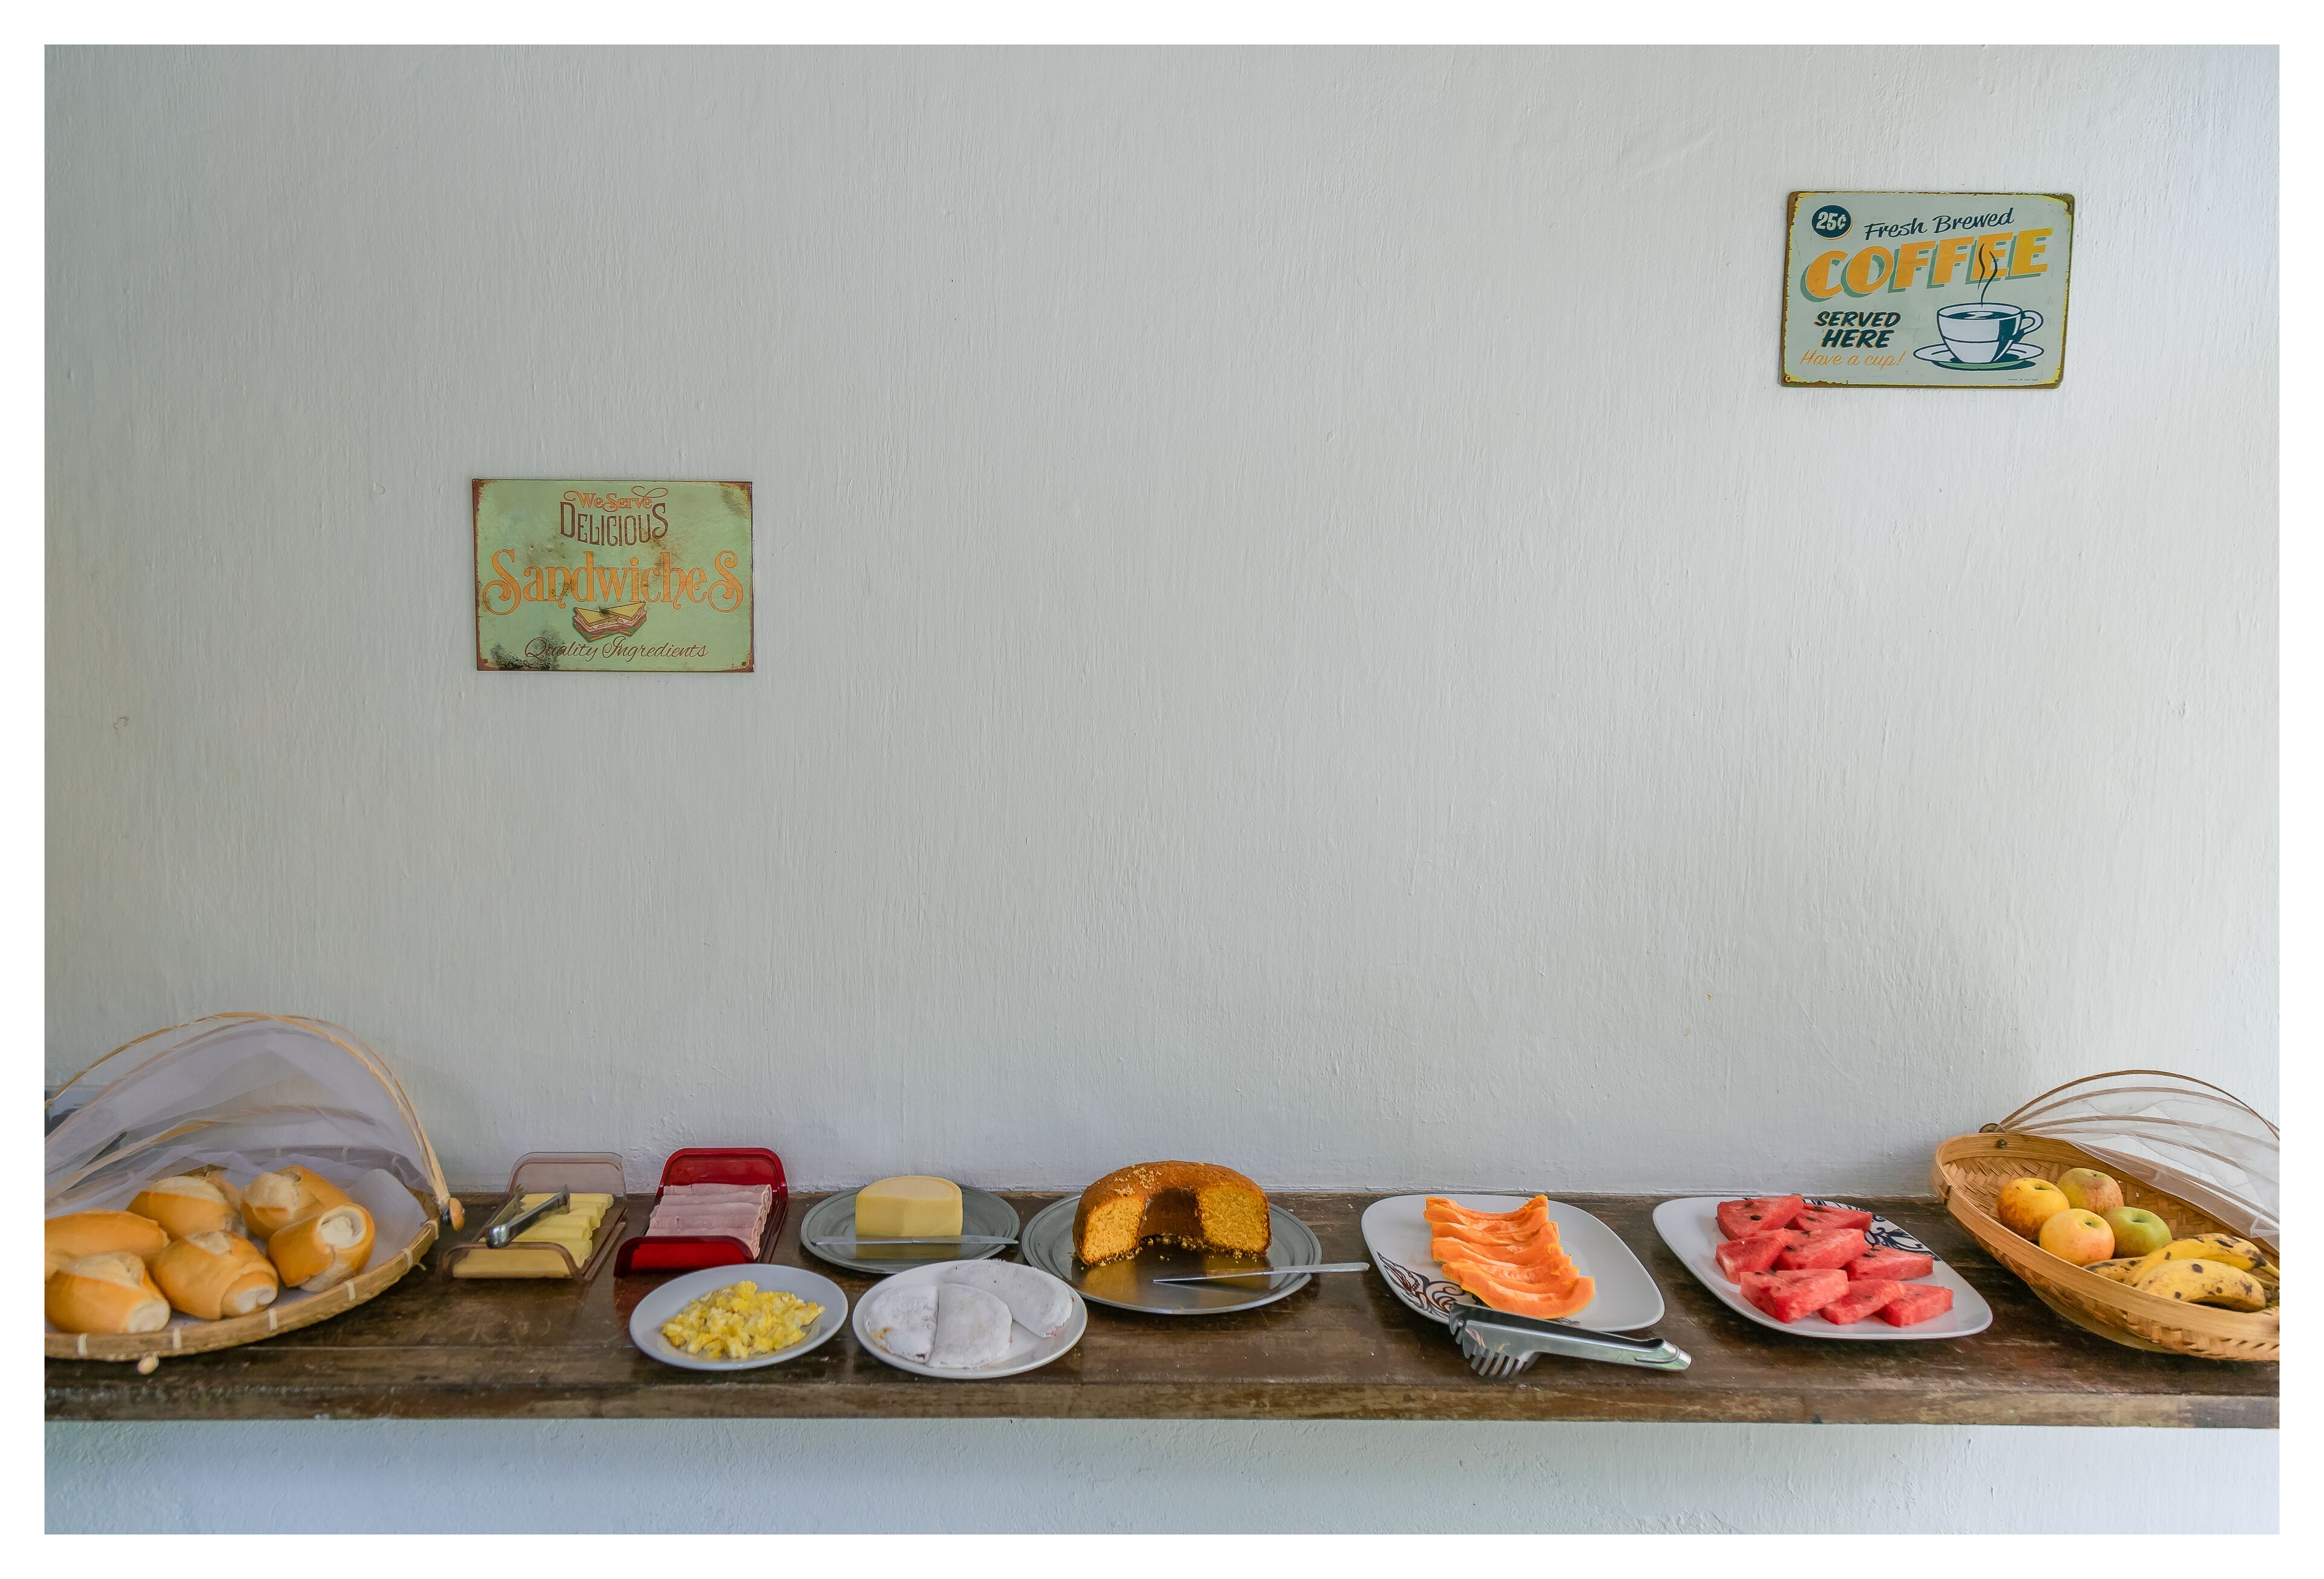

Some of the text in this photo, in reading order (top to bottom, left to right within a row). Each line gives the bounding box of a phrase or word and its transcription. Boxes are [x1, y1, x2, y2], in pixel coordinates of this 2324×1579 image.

[1815, 211, 1848, 231] 25¢
[1864, 208, 2015, 240] Fresh Brewed
[1800, 228, 2053, 302] COFFEE
[1813, 311, 1901, 328] SERVED
[1821, 329, 1894, 349] HERE
[1800, 349, 1906, 371] Have a cup!
[563, 486, 669, 512] We Serve
[560, 501, 669, 547] DELICIOUS
[524, 635, 709, 663] Quality Ingredients
